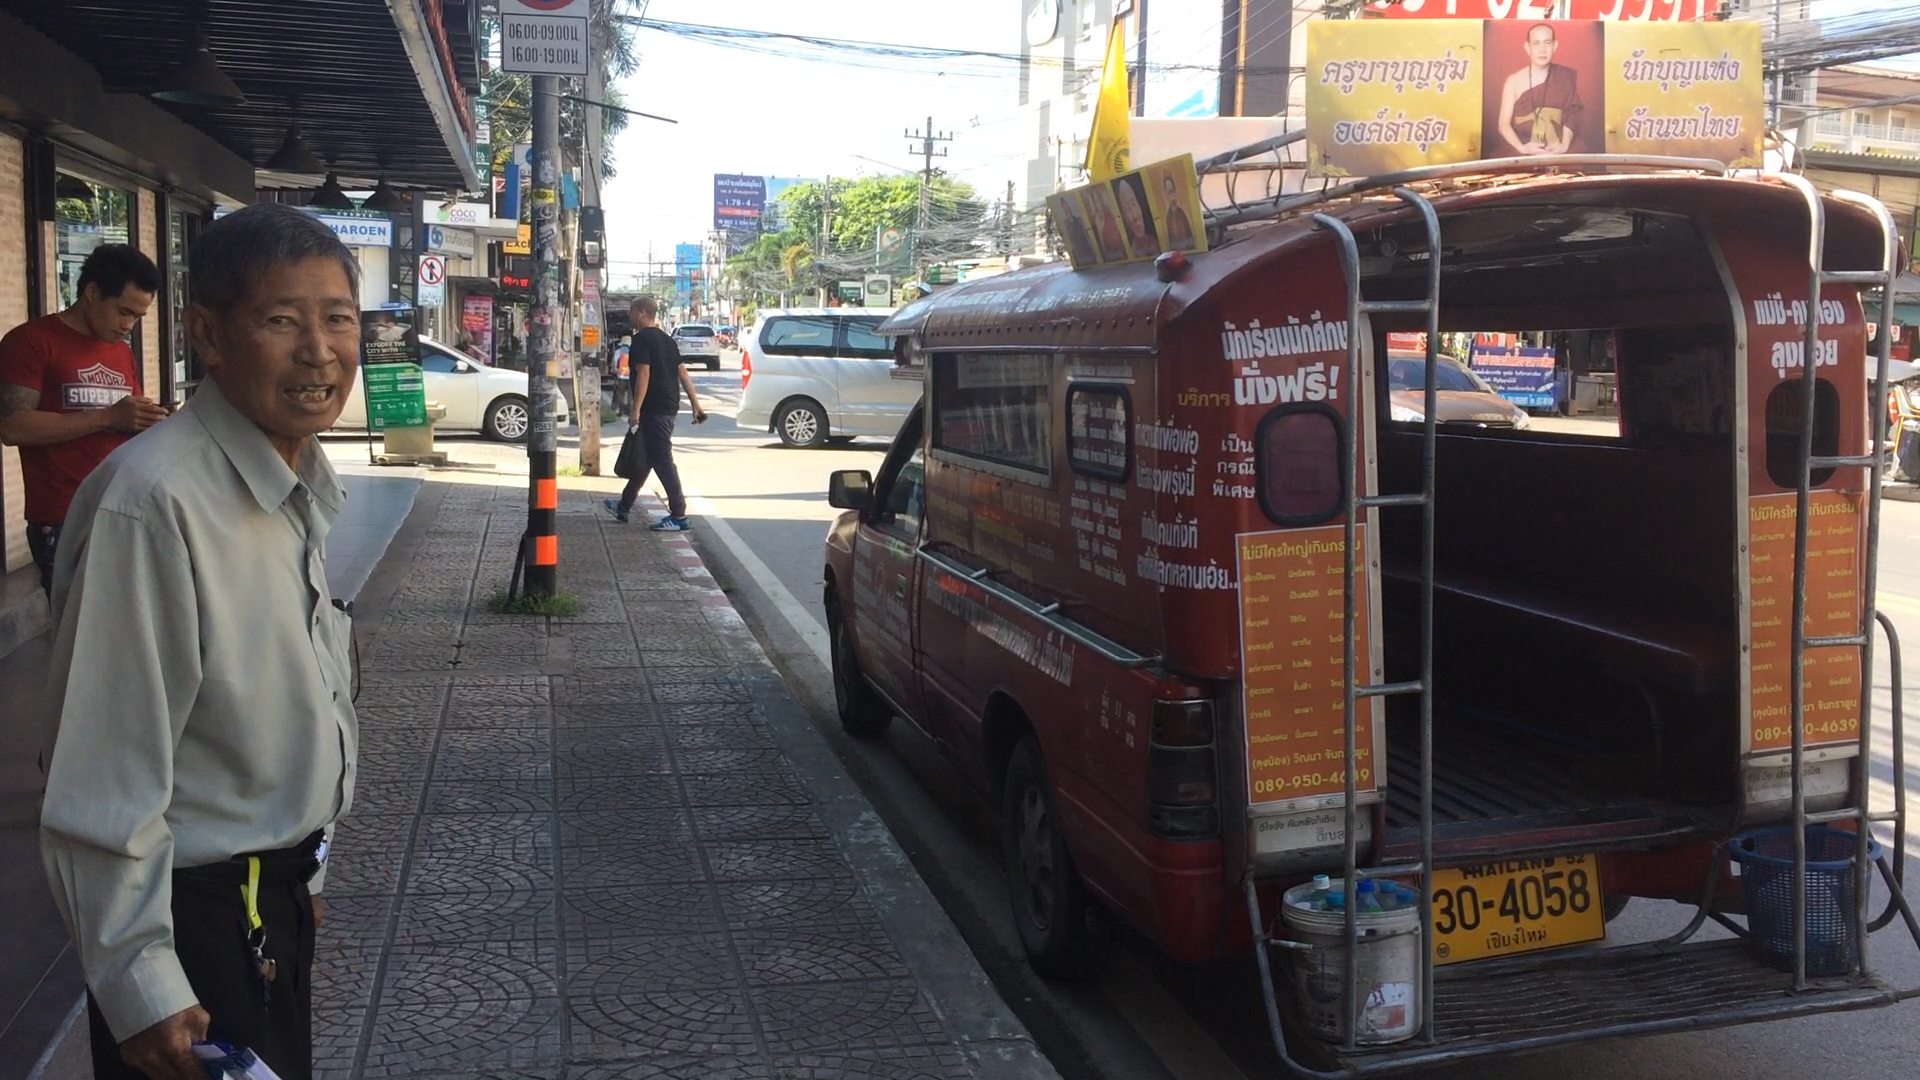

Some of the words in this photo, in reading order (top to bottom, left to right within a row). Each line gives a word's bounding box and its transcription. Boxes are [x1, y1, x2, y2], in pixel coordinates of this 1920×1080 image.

[1322, 51, 1470, 94] ครูบาบุญชุ่ม
[1622, 50, 1741, 95] นักบุญแห่ง
[1333, 106, 1449, 152] องค์ล่าสุด
[1624, 105, 1741, 144] ล้านนาไทย
[451, 209, 476, 217] COCO
[330, 224, 387, 236] HAROEN
[1221, 310, 1350, 360] นักเรียนนักศึกษ
[86, 370, 121, 386] MOTOR
[1177, 387, 1231, 407] บริการ
[1233, 361, 1340, 405] นั่งฟรี!
[69, 387, 110, 403] SUPER
[1221, 433, 1254, 453] เป็น
[1217, 457, 1256, 475] กรณี
[1212, 479, 1256, 498] พิเศษ
[1754, 718, 1858, 742] 089-90-4639
[1432, 868, 1592, 935] 30-4058
[1486, 924, 1548, 950] เชียงใหม่
